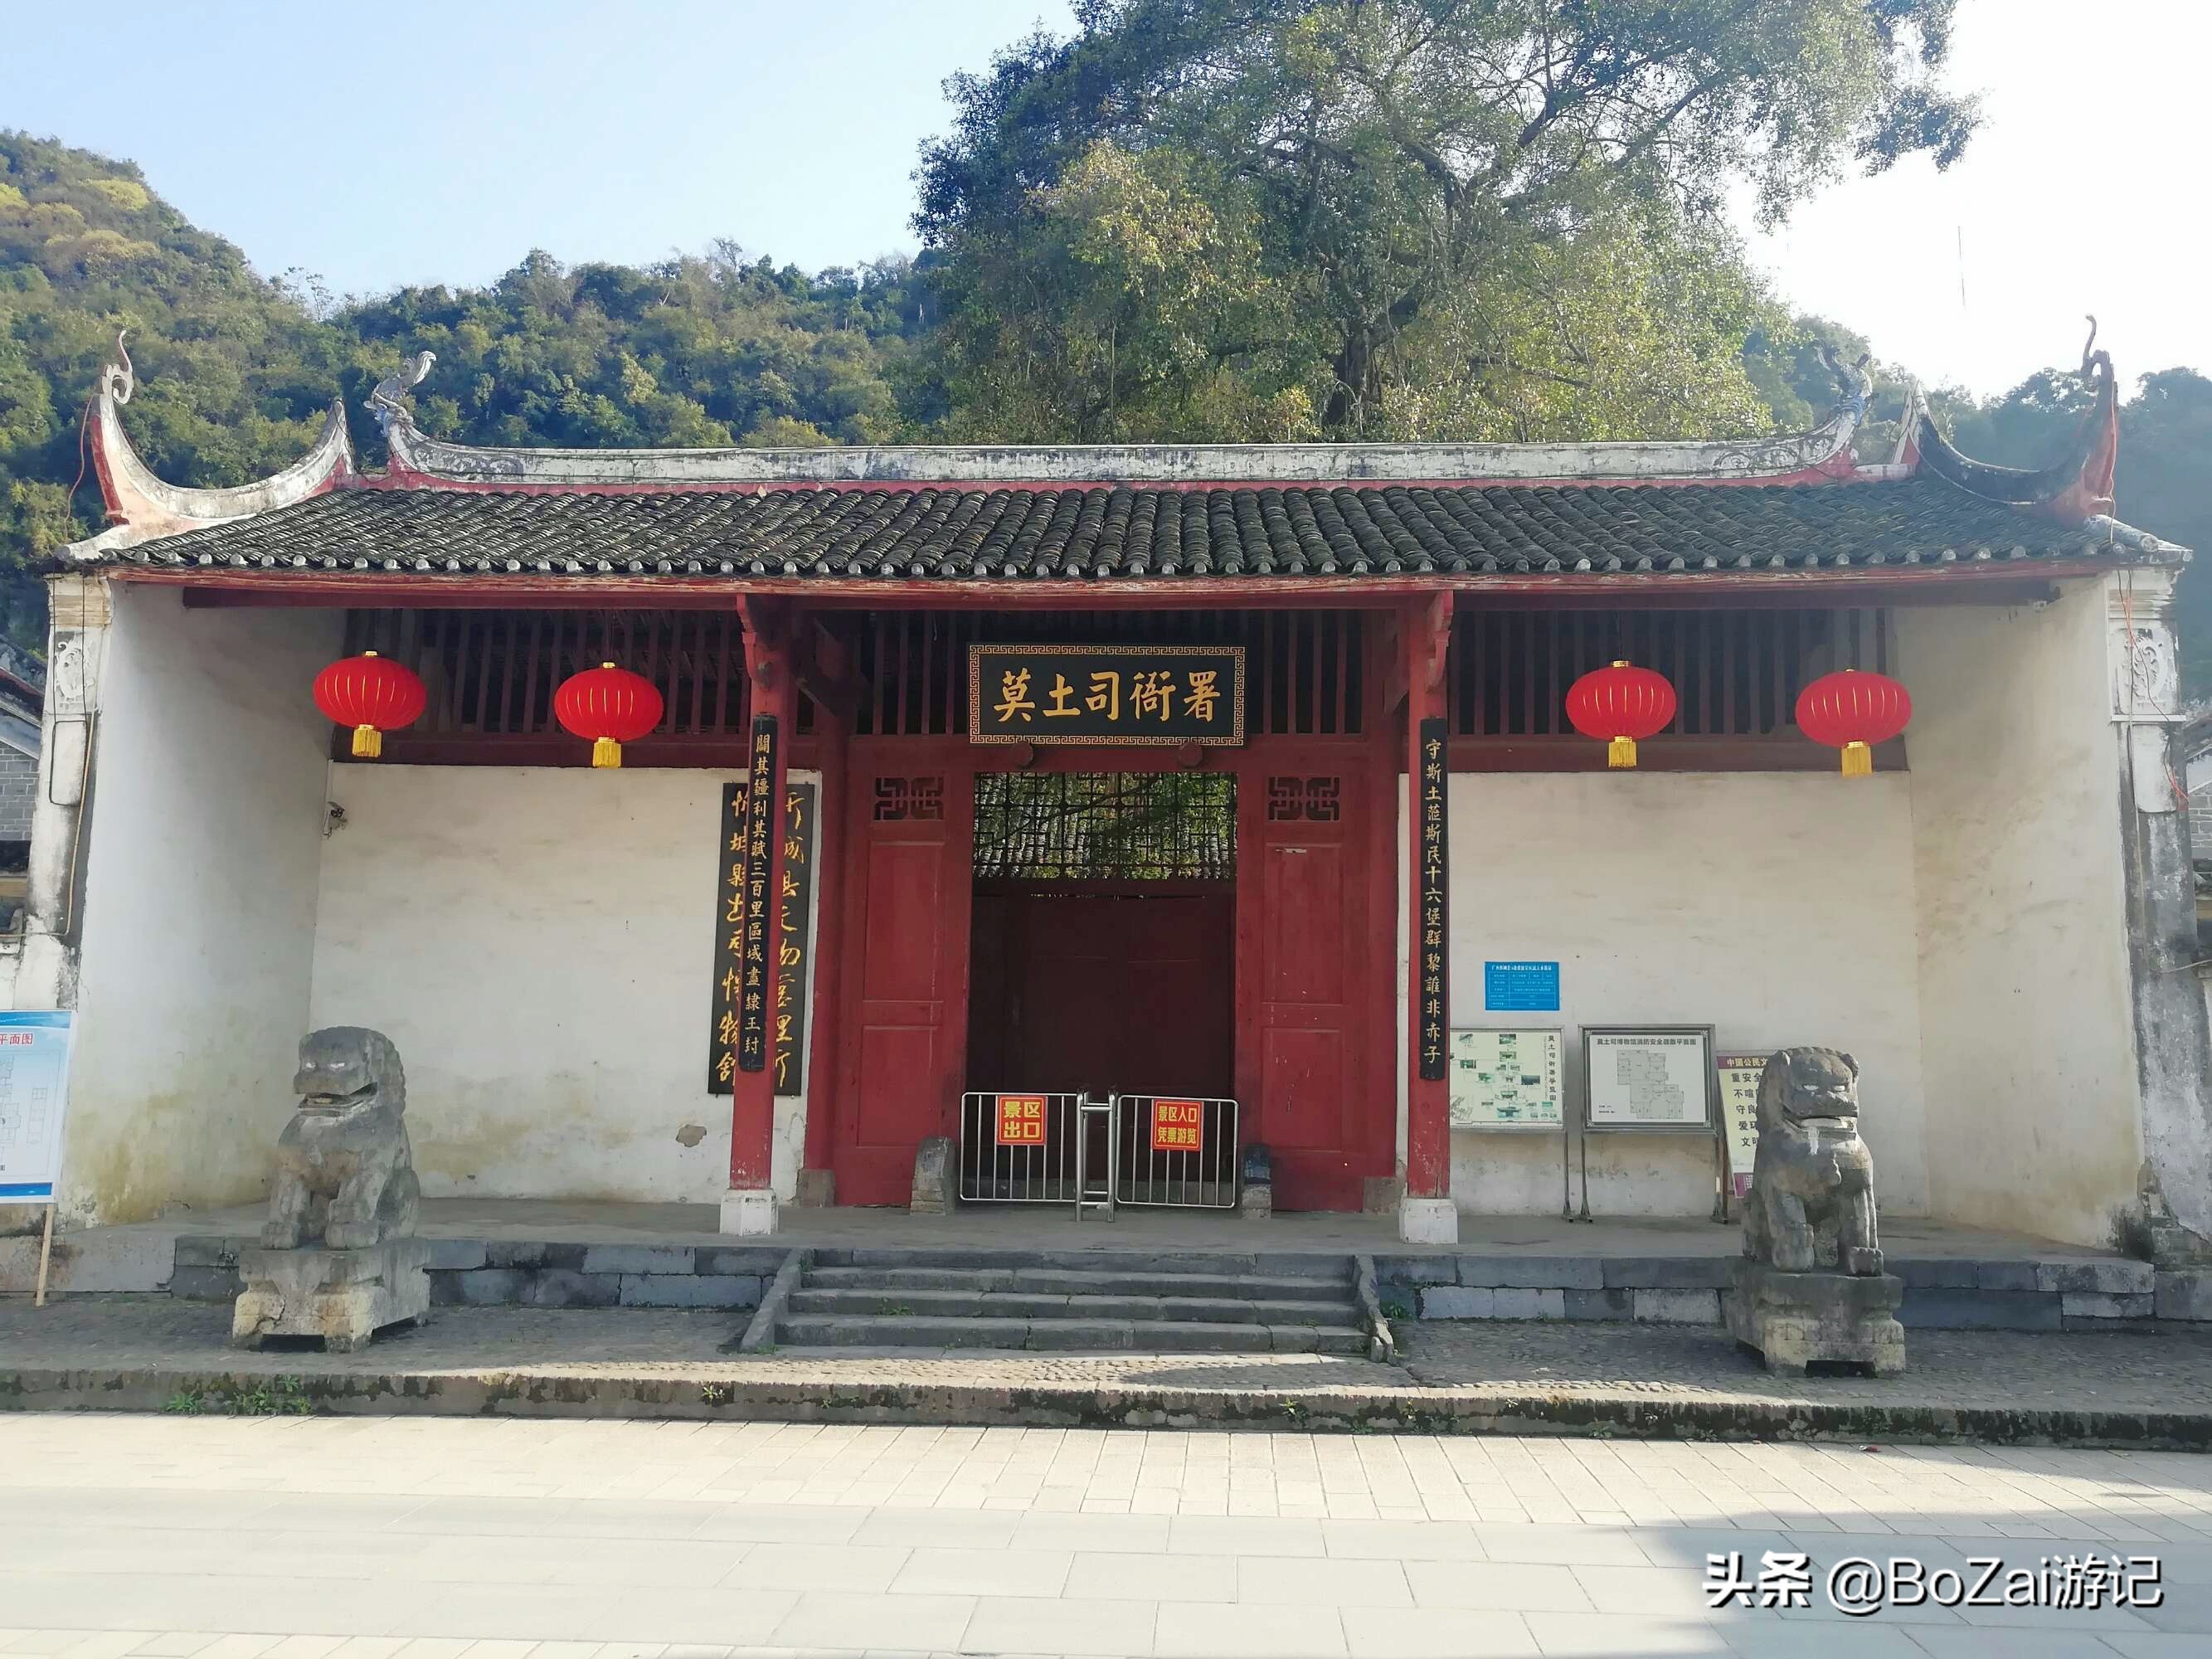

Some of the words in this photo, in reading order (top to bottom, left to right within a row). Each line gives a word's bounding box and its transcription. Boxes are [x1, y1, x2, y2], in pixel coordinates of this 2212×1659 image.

[994, 667, 1221, 722] 莫土司衙署
[1733, 1088, 1759, 1098] 不喧
[1004, 1101, 1040, 1118] 景区
[1004, 1121, 1040, 1139] 出口
[1157, 1126, 1198, 1145] 凭票游览
